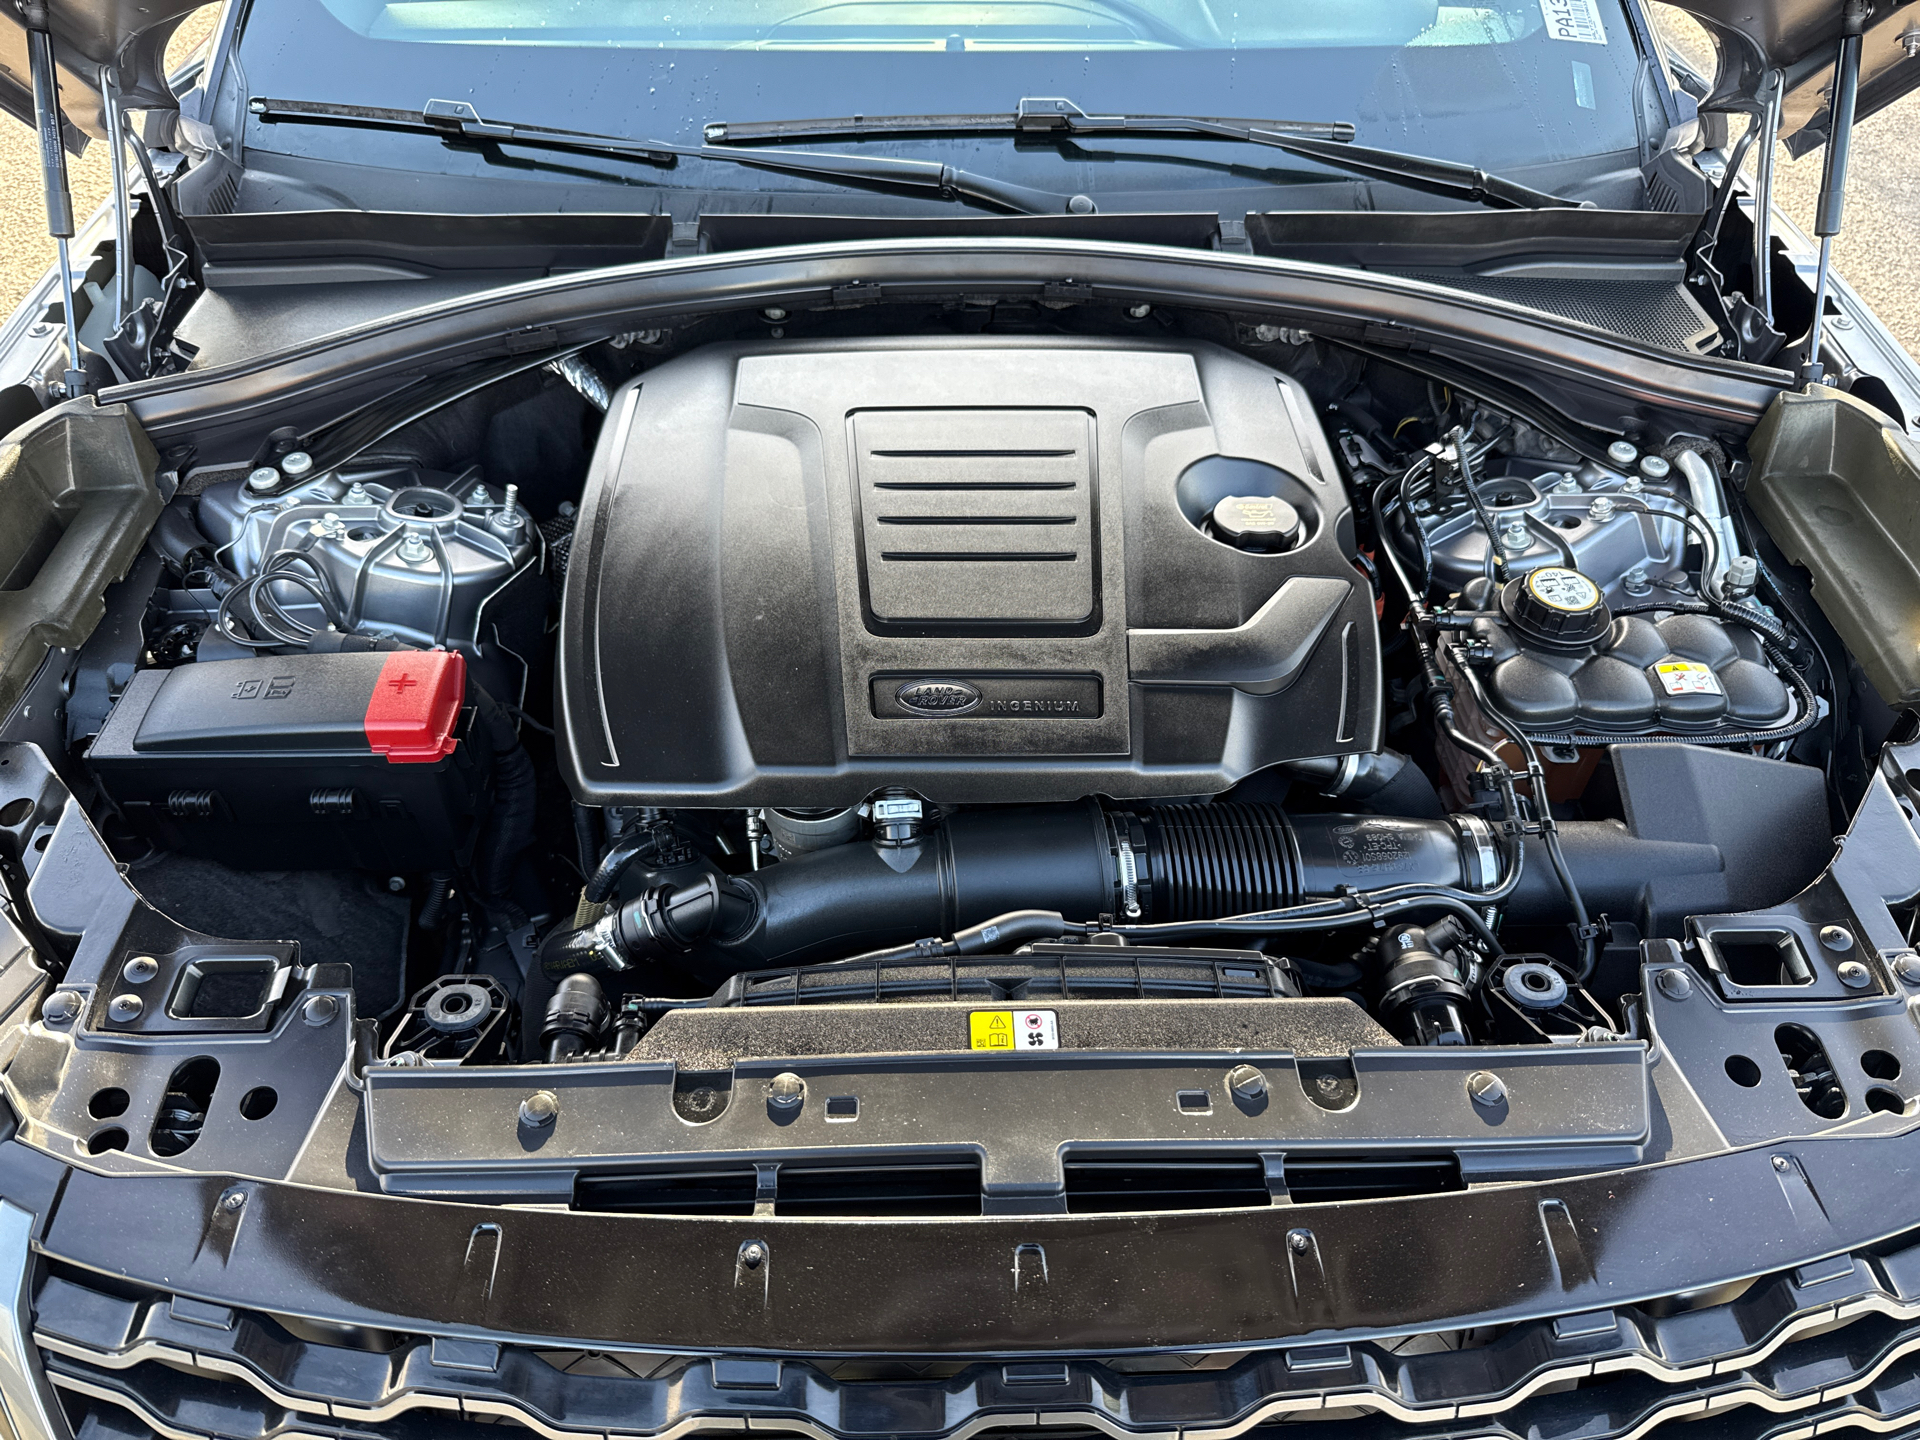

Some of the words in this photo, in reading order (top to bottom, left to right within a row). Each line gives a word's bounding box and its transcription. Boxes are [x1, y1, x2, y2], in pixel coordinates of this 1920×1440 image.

[915, 686, 954, 696] LAND
[917, 695, 967, 706] ROVER
[990, 700, 1081, 712] INGENIUM
